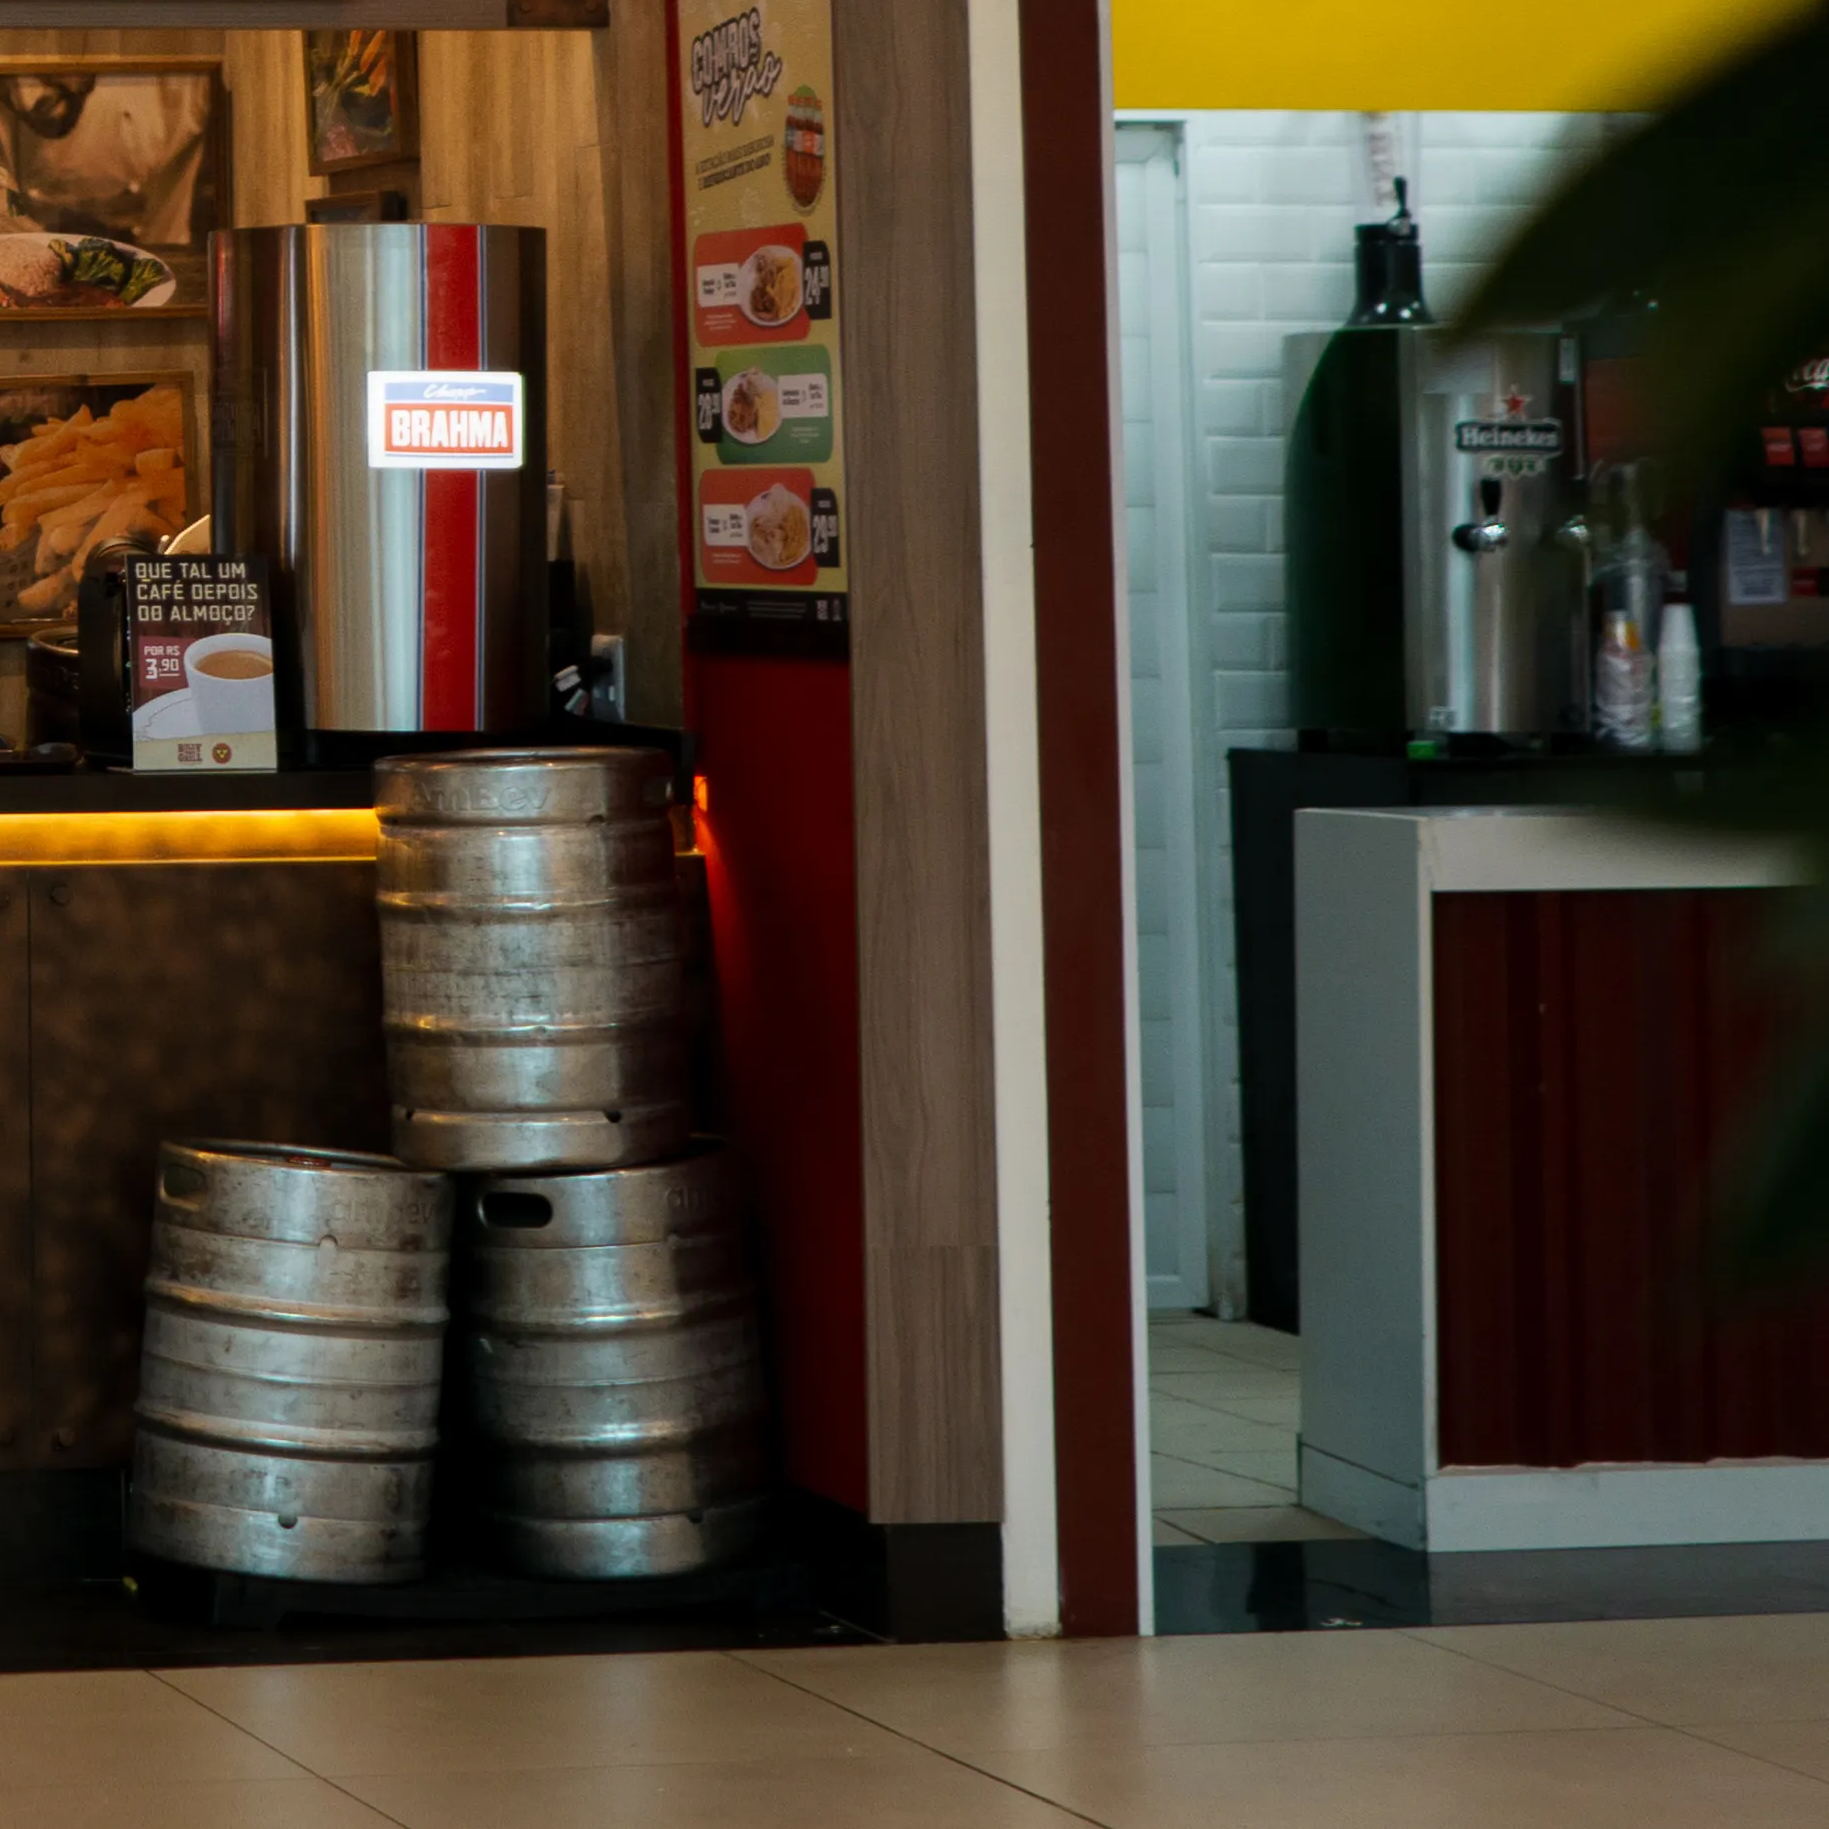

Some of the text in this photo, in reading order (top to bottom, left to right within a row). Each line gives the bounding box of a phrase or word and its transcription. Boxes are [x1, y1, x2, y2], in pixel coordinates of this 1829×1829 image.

[391, 409, 509, 448] BRAHMA
[135, 562, 247, 582] QUE TAL UM
[137, 579, 259, 601] CAFÉ DEPOIS
[137, 605, 256, 626] DO ALMOÇO?
[144, 645, 165, 656] POR
